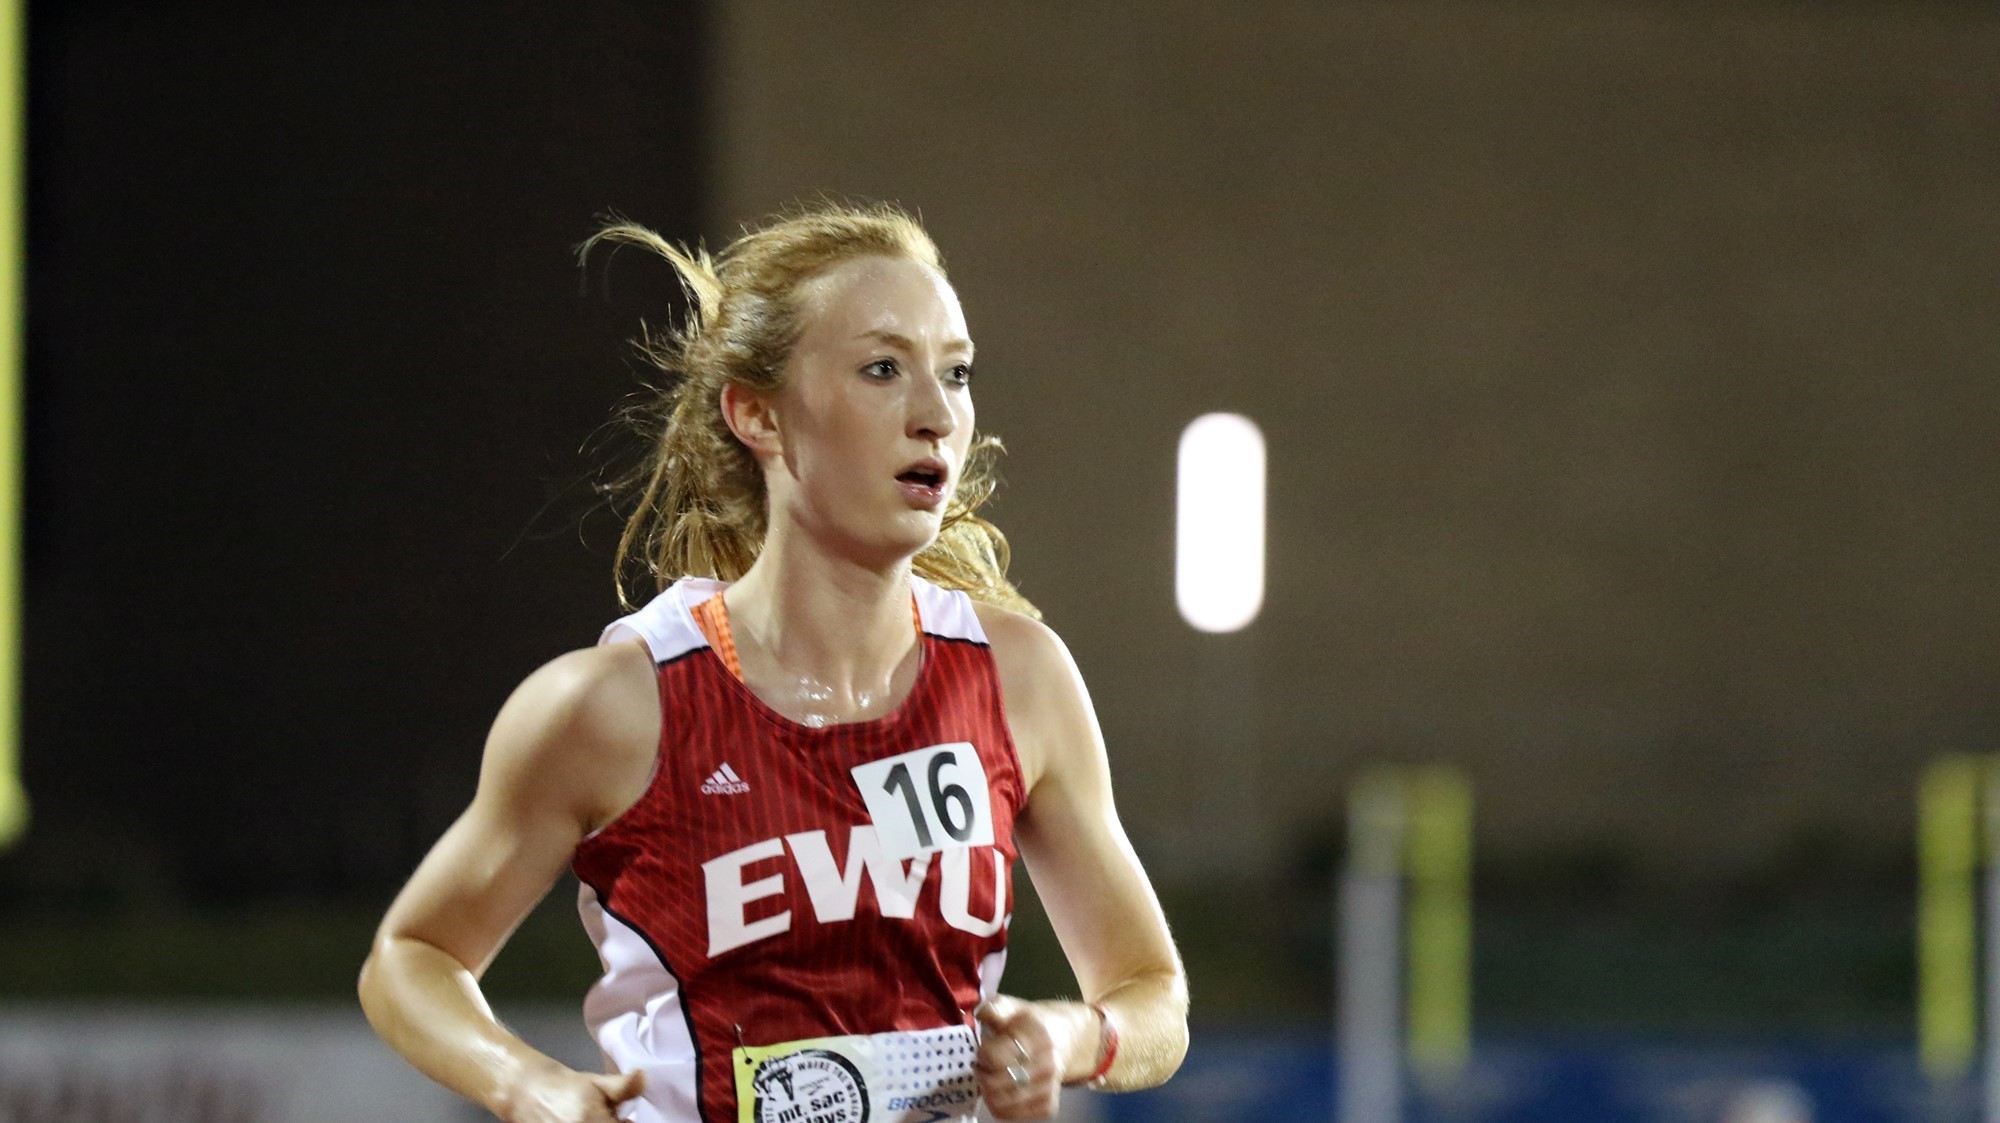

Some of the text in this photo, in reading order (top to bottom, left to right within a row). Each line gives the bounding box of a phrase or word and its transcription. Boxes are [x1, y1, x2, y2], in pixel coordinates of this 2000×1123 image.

[701, 782, 751, 796] adidas
[883, 751, 976, 849] 16
[701, 824, 1006, 959] EWU
[777, 1103, 808, 1123] mt.
[810, 1090, 846, 1112] sac
[887, 1091, 966, 1111] BROOKS
